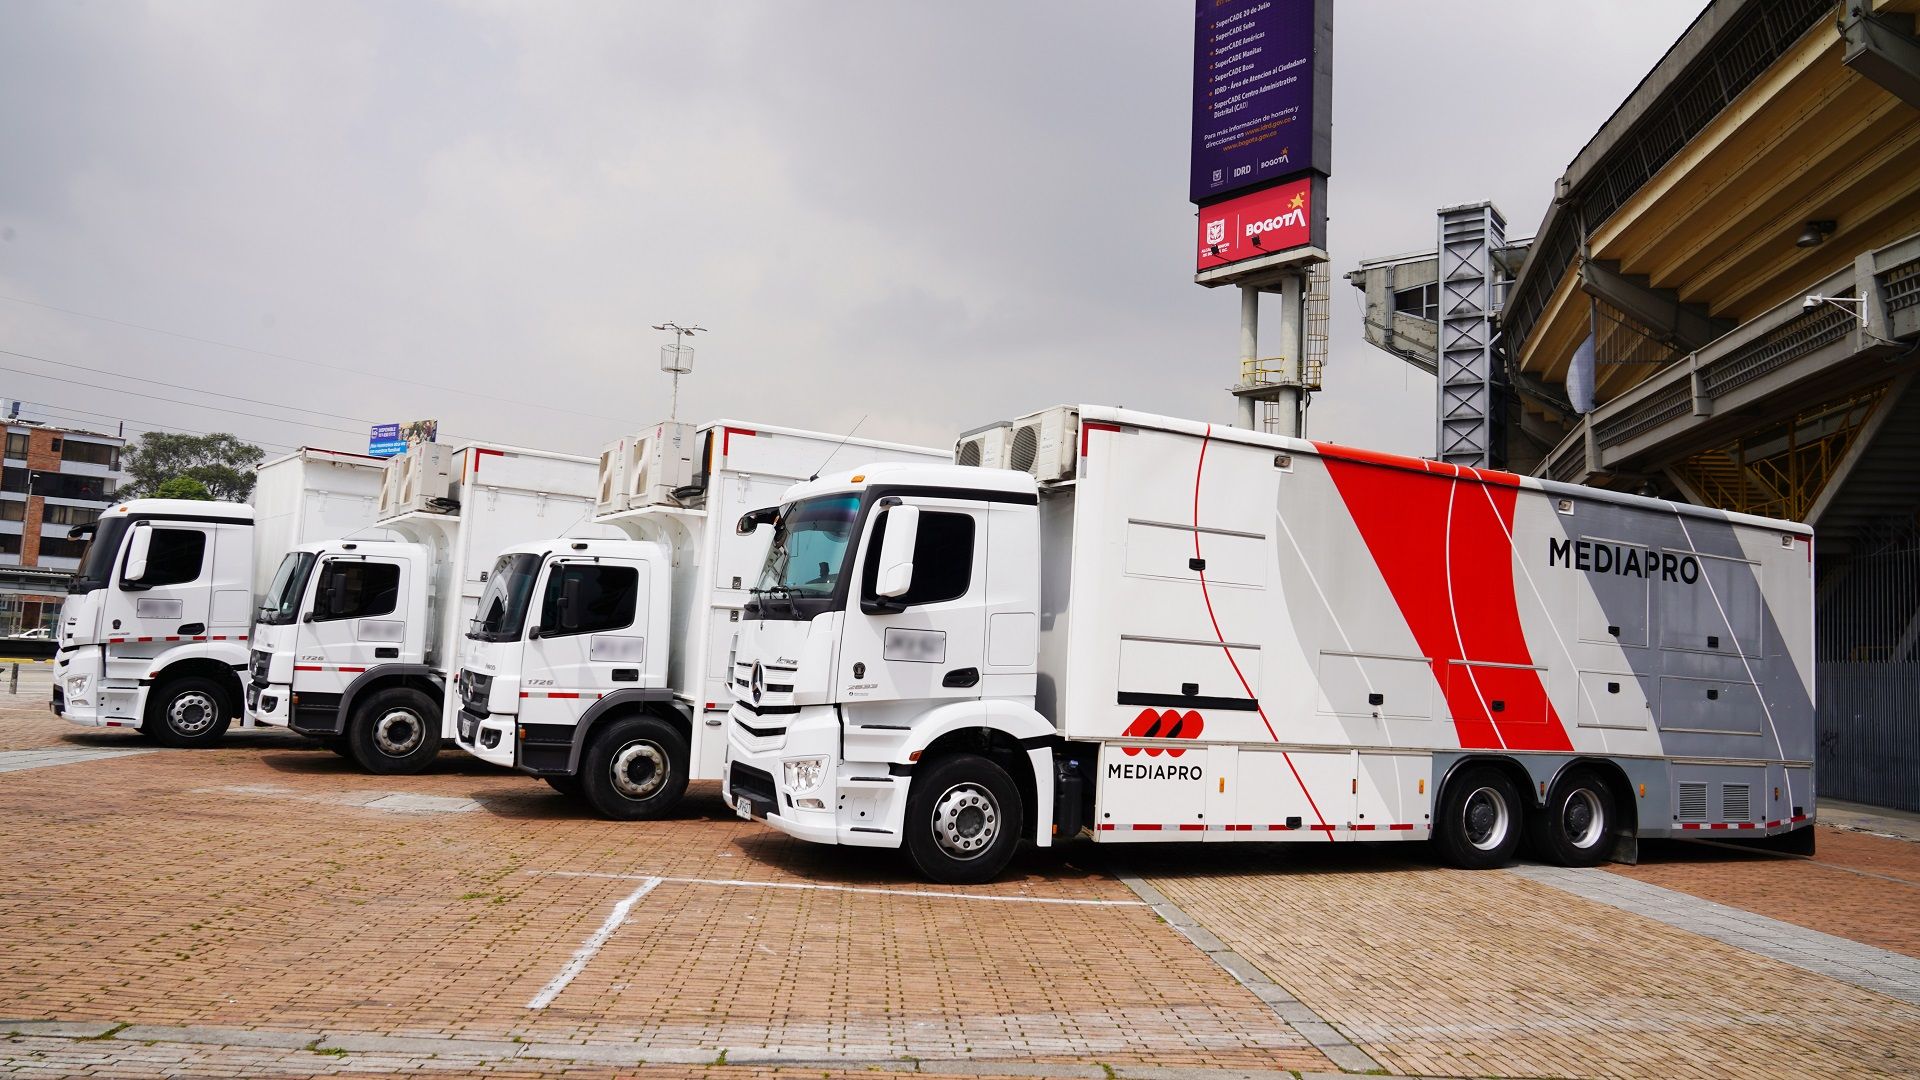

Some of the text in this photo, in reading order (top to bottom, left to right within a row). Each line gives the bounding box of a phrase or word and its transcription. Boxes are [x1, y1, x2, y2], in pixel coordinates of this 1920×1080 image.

[1215, 12, 1242, 28] SuperCADE
[1243, 9, 1250, 18] 20
[1258, 2, 1270, 11] Julio
[1215, 22, 1256, 41] SuperCADE Suba
[1215, 39, 1242, 55] SuperCADE
[1214, 52, 1242, 68] SuperCADE
[1214, 64, 1254, 82] SuperCADE Bosa
[1214, 86, 1227, 95] IDRD
[1272, 66, 1278, 74] al
[1278, 58, 1306, 72] Ciudadano
[1214, 76, 1298, 109] SuperCADE Centro Administrativo
[1214, 106, 1234, 118] Distrital
[1204, 132, 1216, 140] Para
[1228, 118, 1262, 132] información
[1262, 114, 1270, 122] de
[1270, 107, 1294, 118] horarios
[1206, 134, 1236, 148] direcciones
[1234, 164, 1252, 178] IDRD
[1550, 537, 1699, 584] MEDIAPRO
[1108, 764, 1202, 780] MEDIAPRO
